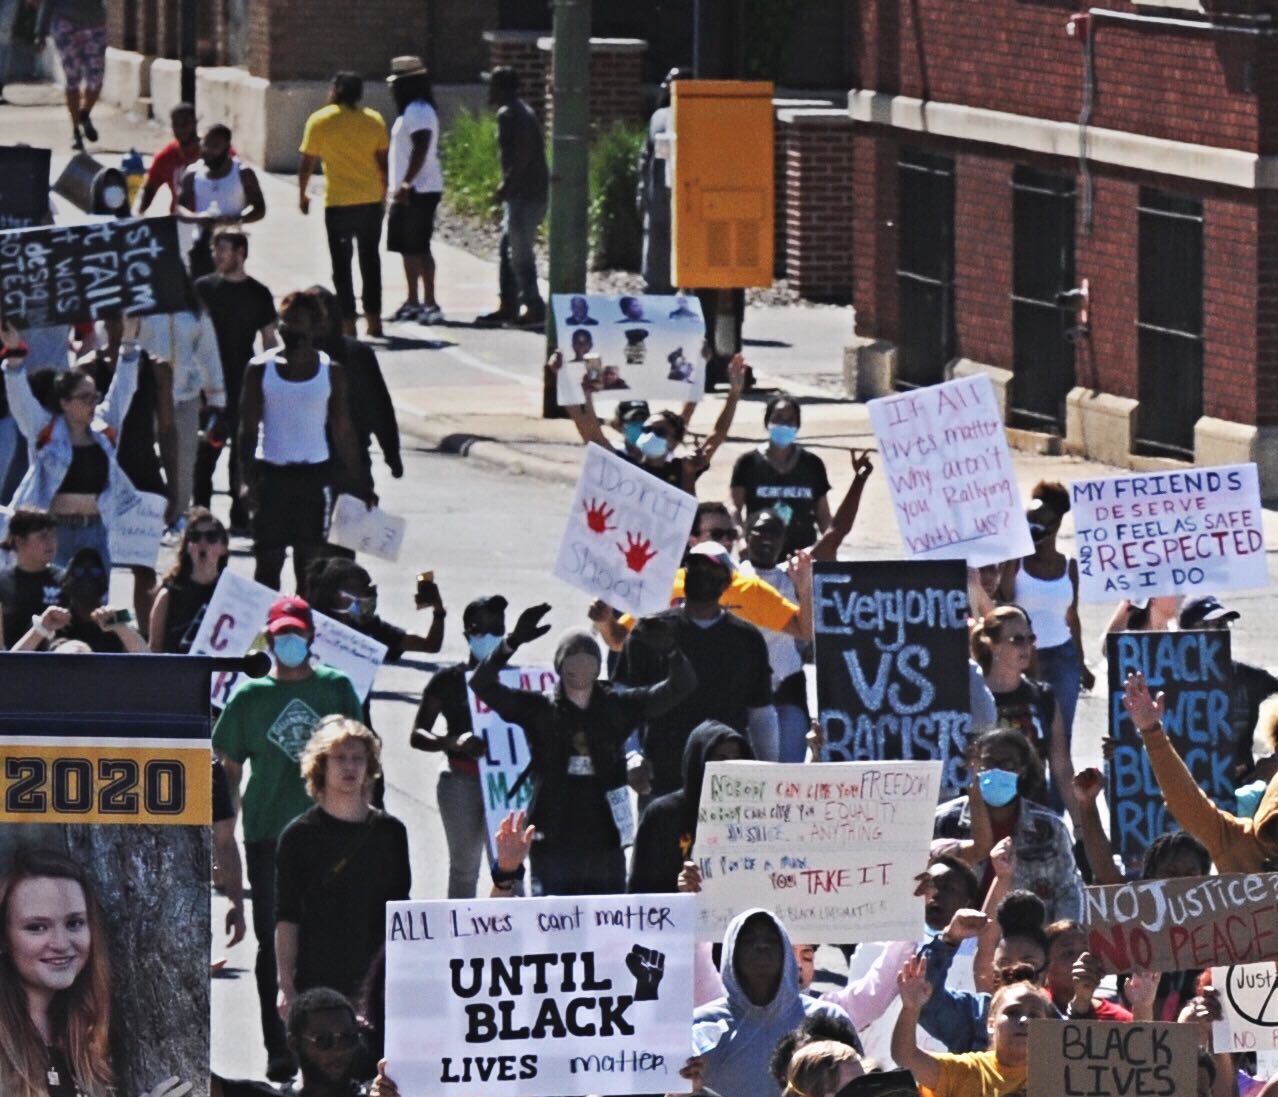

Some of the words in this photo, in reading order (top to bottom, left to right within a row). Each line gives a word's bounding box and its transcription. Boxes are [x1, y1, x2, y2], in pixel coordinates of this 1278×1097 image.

[0, 233, 27, 318] ROTECT
[80, 251, 123, 320] FAIL
[1072, 480, 1106, 504] MY
[1114, 471, 1243, 499] FRIENDS
[1078, 527, 1109, 544] TO
[1116, 521, 1169, 542] FEEL
[1174, 516, 1198, 535] AS
[1203, 510, 1254, 531] SAFE
[1095, 496, 1208, 523] DESERVE
[1079, 544, 1094, 578] AND
[1096, 529, 1264, 573] RESPECTED
[1103, 573, 1131, 593] AS
[1139, 570, 1158, 589] I
[1171, 566, 1206, 587] DO
[812, 573, 971, 652] Everyone
[842, 643, 937, 716] VS
[1116, 633, 1226, 687] BLACK
[1113, 688, 1234, 745] PWER
[5, 757, 186, 816] 2020
[859, 770, 931, 800] FREEDOM
[1114, 744, 1236, 798] BLCK
[823, 801, 898, 824] EQUALITY
[800, 868, 852, 896] TAKE
[858, 861, 894, 889] IT
[390, 911, 434, 942] ALL
[450, 907, 513, 939] Lives
[1082, 884, 1135, 925] NO
[1089, 929, 1152, 973] NO
[450, 951, 613, 999] UNTIL
[464, 995, 636, 1044] BLACK
[1233, 1029, 1257, 1049] NO
[1062, 1025, 1173, 1066] BLACK
[440, 1054, 538, 1084] LIVES
[1064, 1064, 1176, 1097] LIVES
